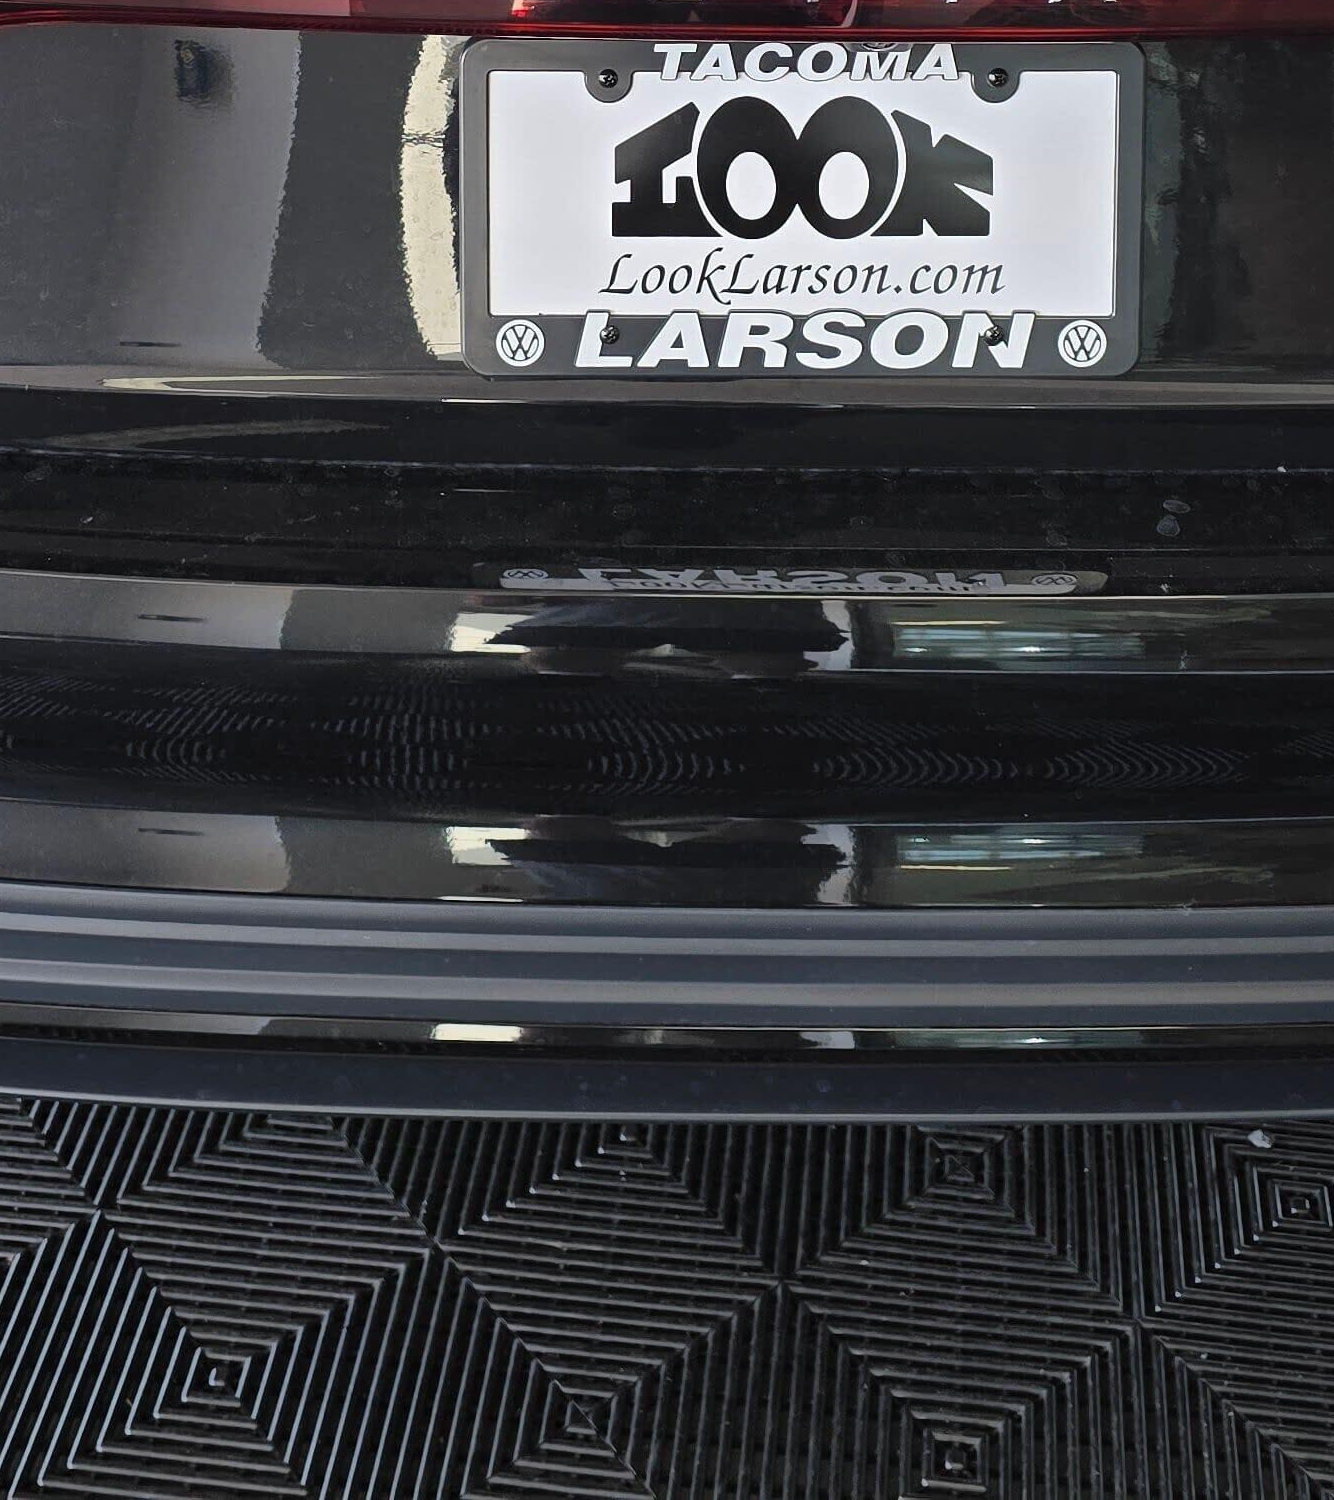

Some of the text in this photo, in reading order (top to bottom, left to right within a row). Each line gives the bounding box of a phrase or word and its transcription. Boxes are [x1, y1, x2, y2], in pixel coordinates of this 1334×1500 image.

[653, 42, 959, 82] TACOMA
[611, 96, 994, 240] LOOK
[599, 247, 1007, 305] LookLarson.com
[575, 310, 1038, 369] LARSON
